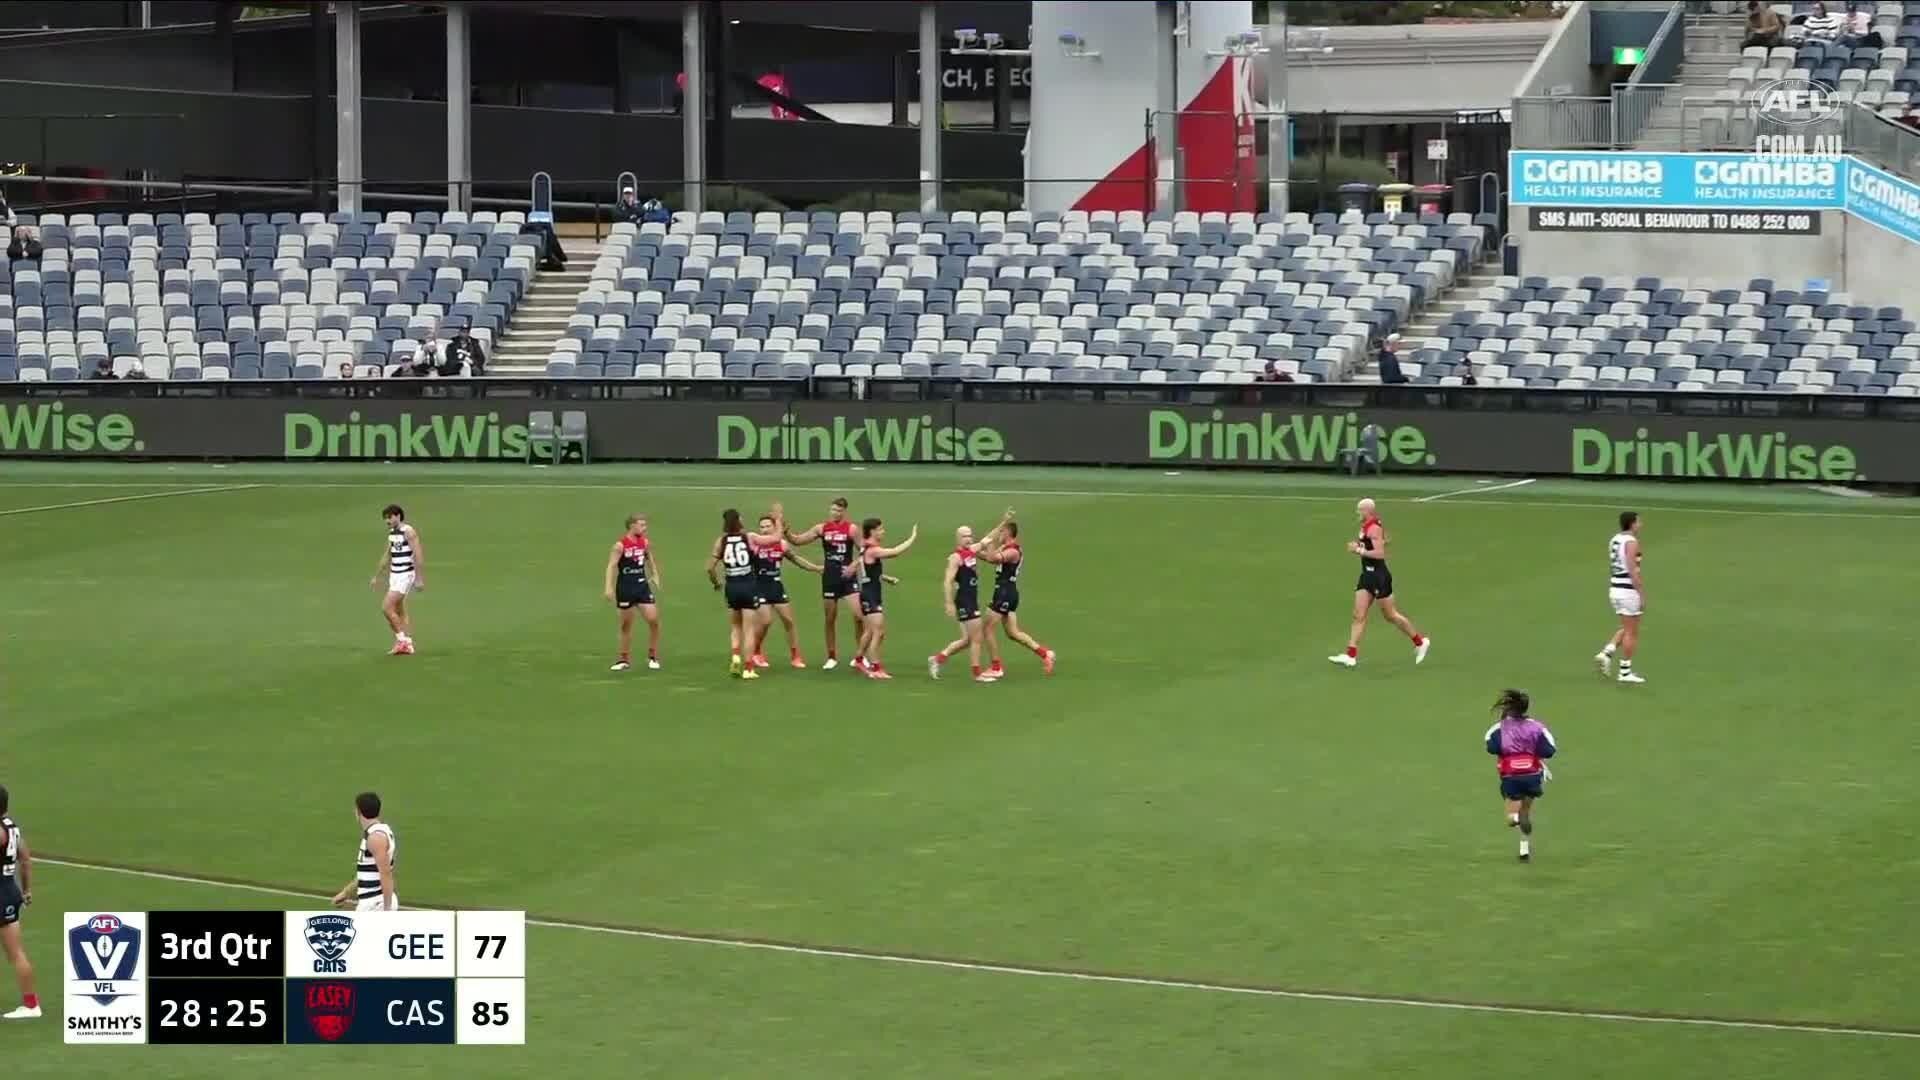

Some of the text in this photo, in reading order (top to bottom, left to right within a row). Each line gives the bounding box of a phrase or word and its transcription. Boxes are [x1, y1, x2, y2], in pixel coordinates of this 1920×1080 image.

[1524, 185, 1663, 199] HEALTH INSURANCE
[1695, 186, 1836, 201] HEALTH INSURANCE
[1539, 211, 1811, 230] SMS ANTI-SOCIAL BEHAVIOUR TO 0488 252 000
[718, 414, 1014, 462] DrinkWise.
[1572, 427, 1867, 481] DrinkWise.
[723, 541, 750, 567] 46
